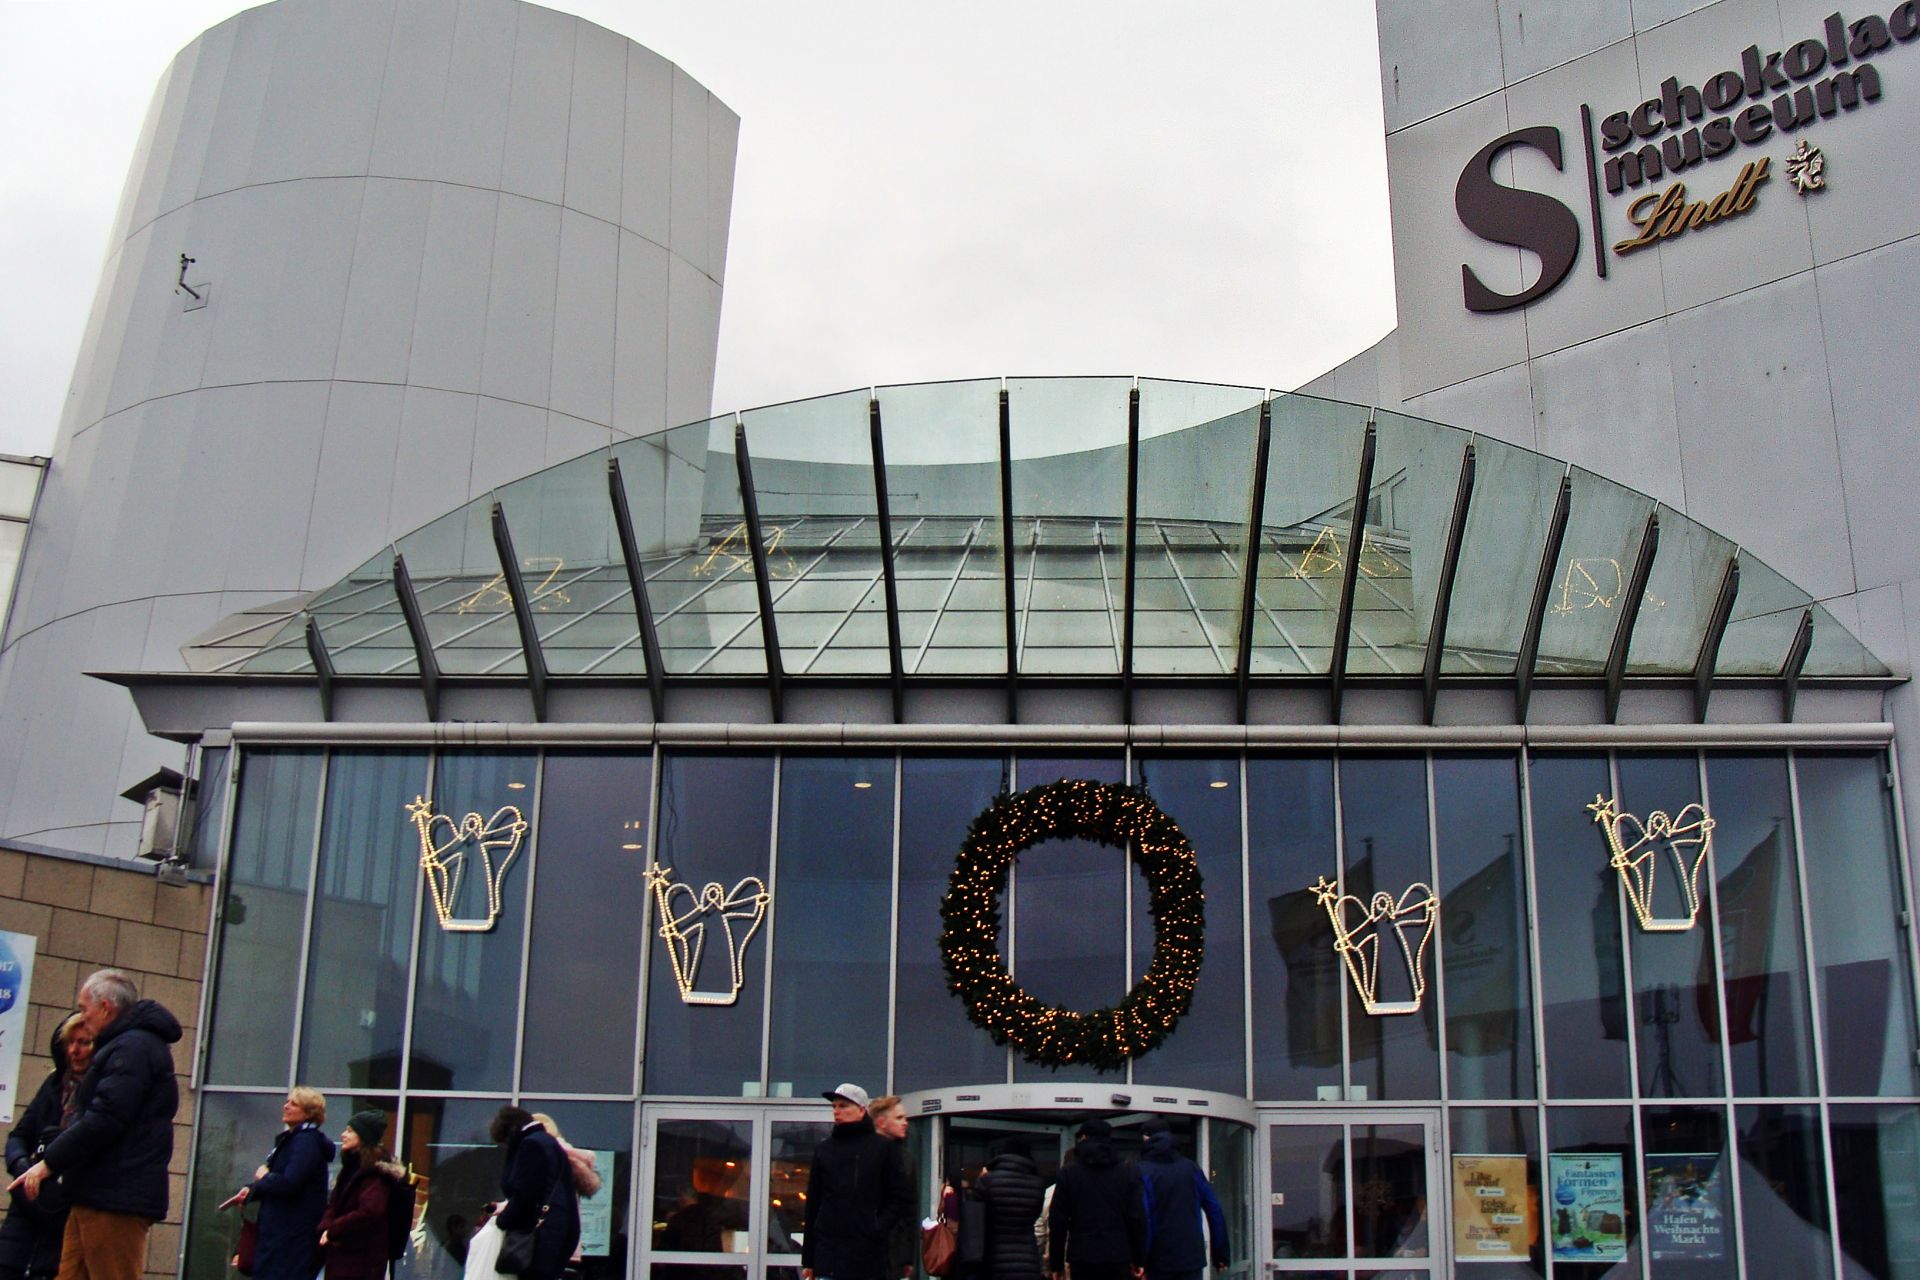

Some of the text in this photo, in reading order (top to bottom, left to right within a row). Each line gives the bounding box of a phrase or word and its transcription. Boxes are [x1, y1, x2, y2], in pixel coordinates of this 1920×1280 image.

[1603, 63, 1882, 193] museum
[1455, 126, 1581, 313] S
[1613, 156, 1770, 256] Lindt
[1653, 1223, 1720, 1234] Weihnachts
[1663, 1214, 1698, 1224] Hafen
[1671, 1234, 1706, 1244] Markt
